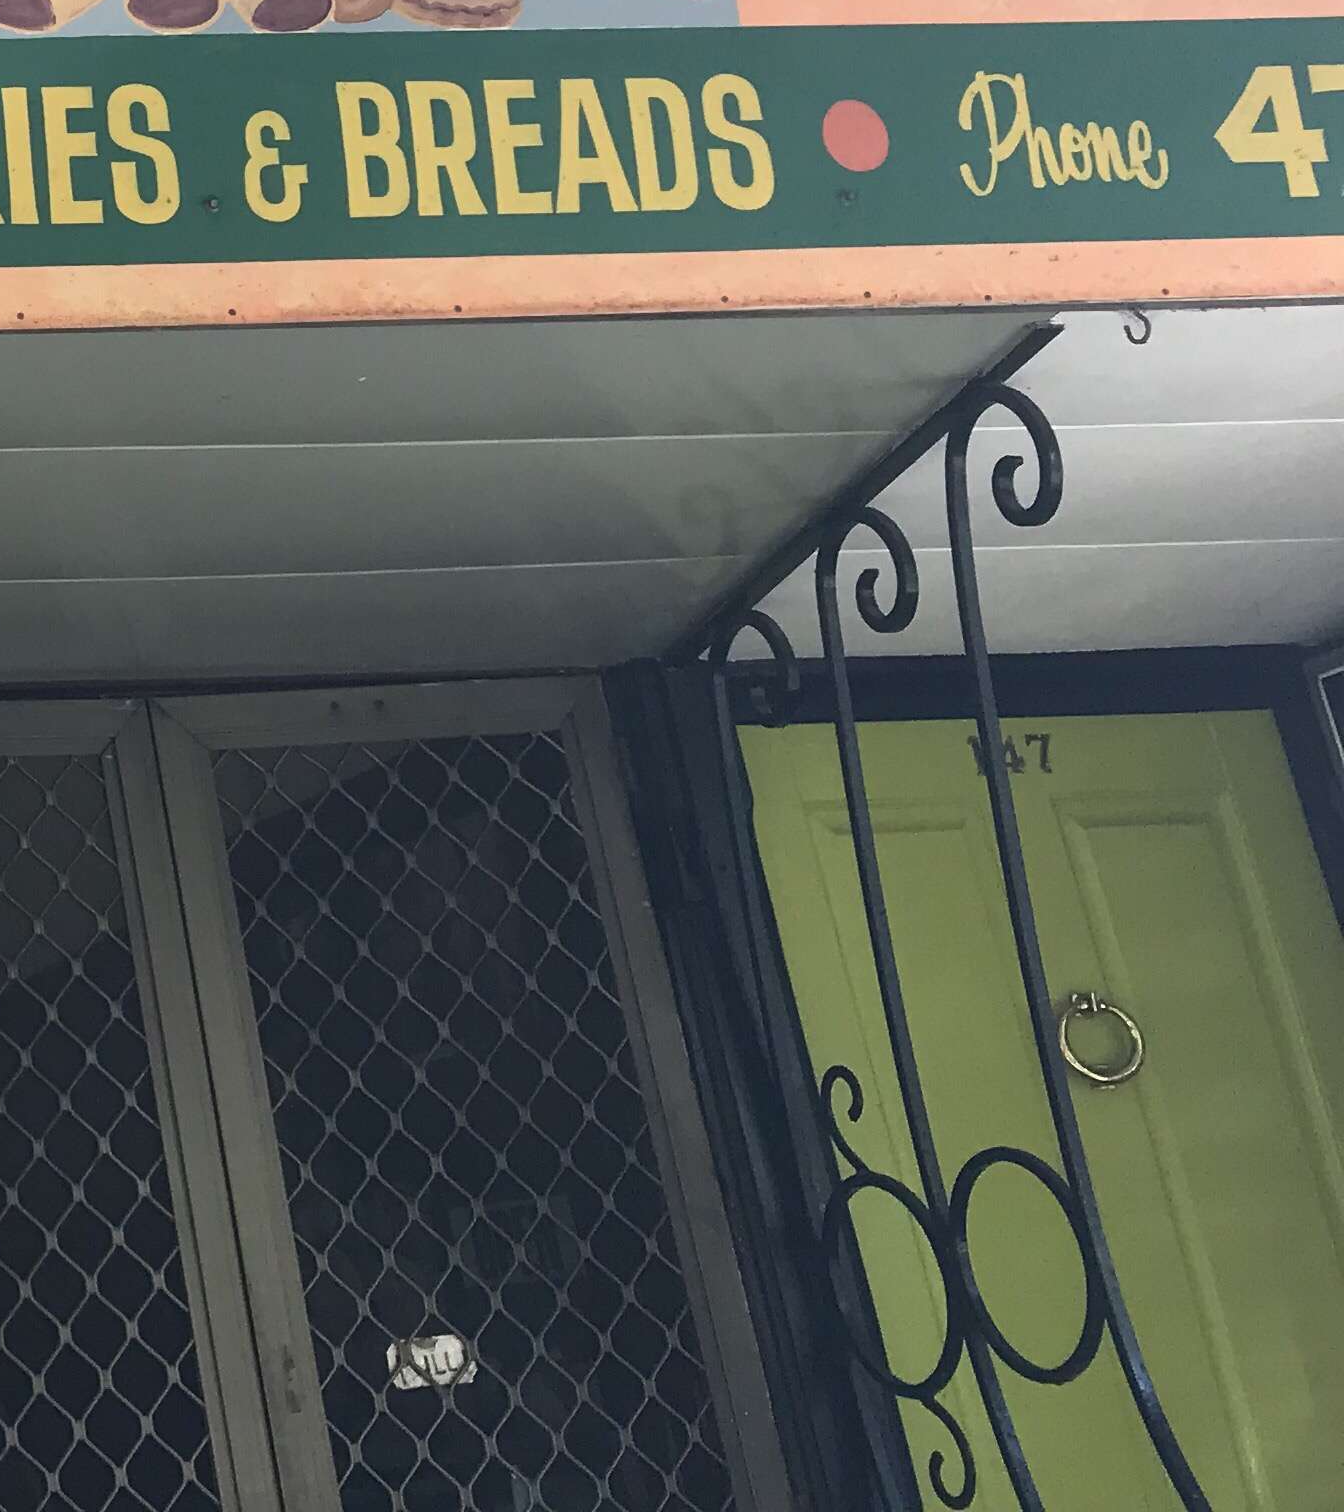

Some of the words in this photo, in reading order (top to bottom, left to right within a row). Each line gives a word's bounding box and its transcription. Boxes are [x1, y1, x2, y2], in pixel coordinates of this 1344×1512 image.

[244, 110, 309, 223] &
[336, 72, 777, 219] BREADS
[958, 70, 1169, 197] Phone
